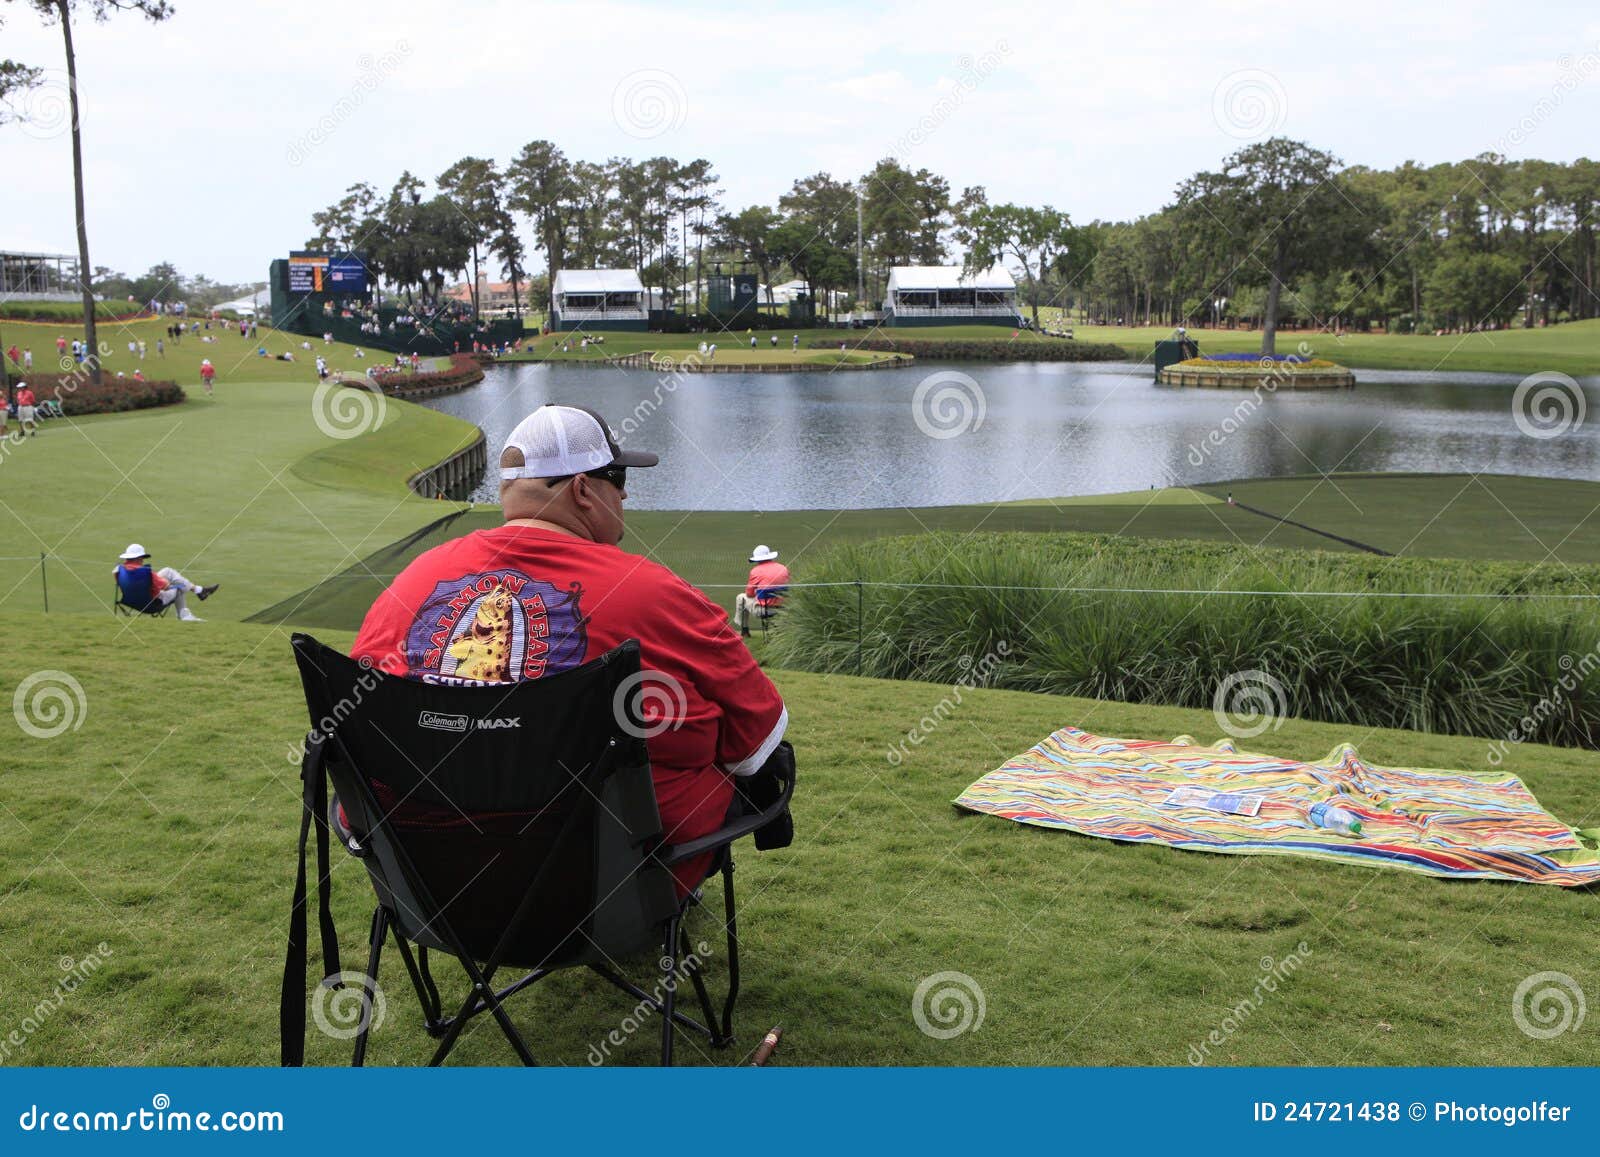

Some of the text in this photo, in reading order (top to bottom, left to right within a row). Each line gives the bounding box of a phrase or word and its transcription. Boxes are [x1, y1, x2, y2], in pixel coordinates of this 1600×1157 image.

[423, 574, 549, 679] SALMON HEAD
[477, 717, 521, 729] MAX
